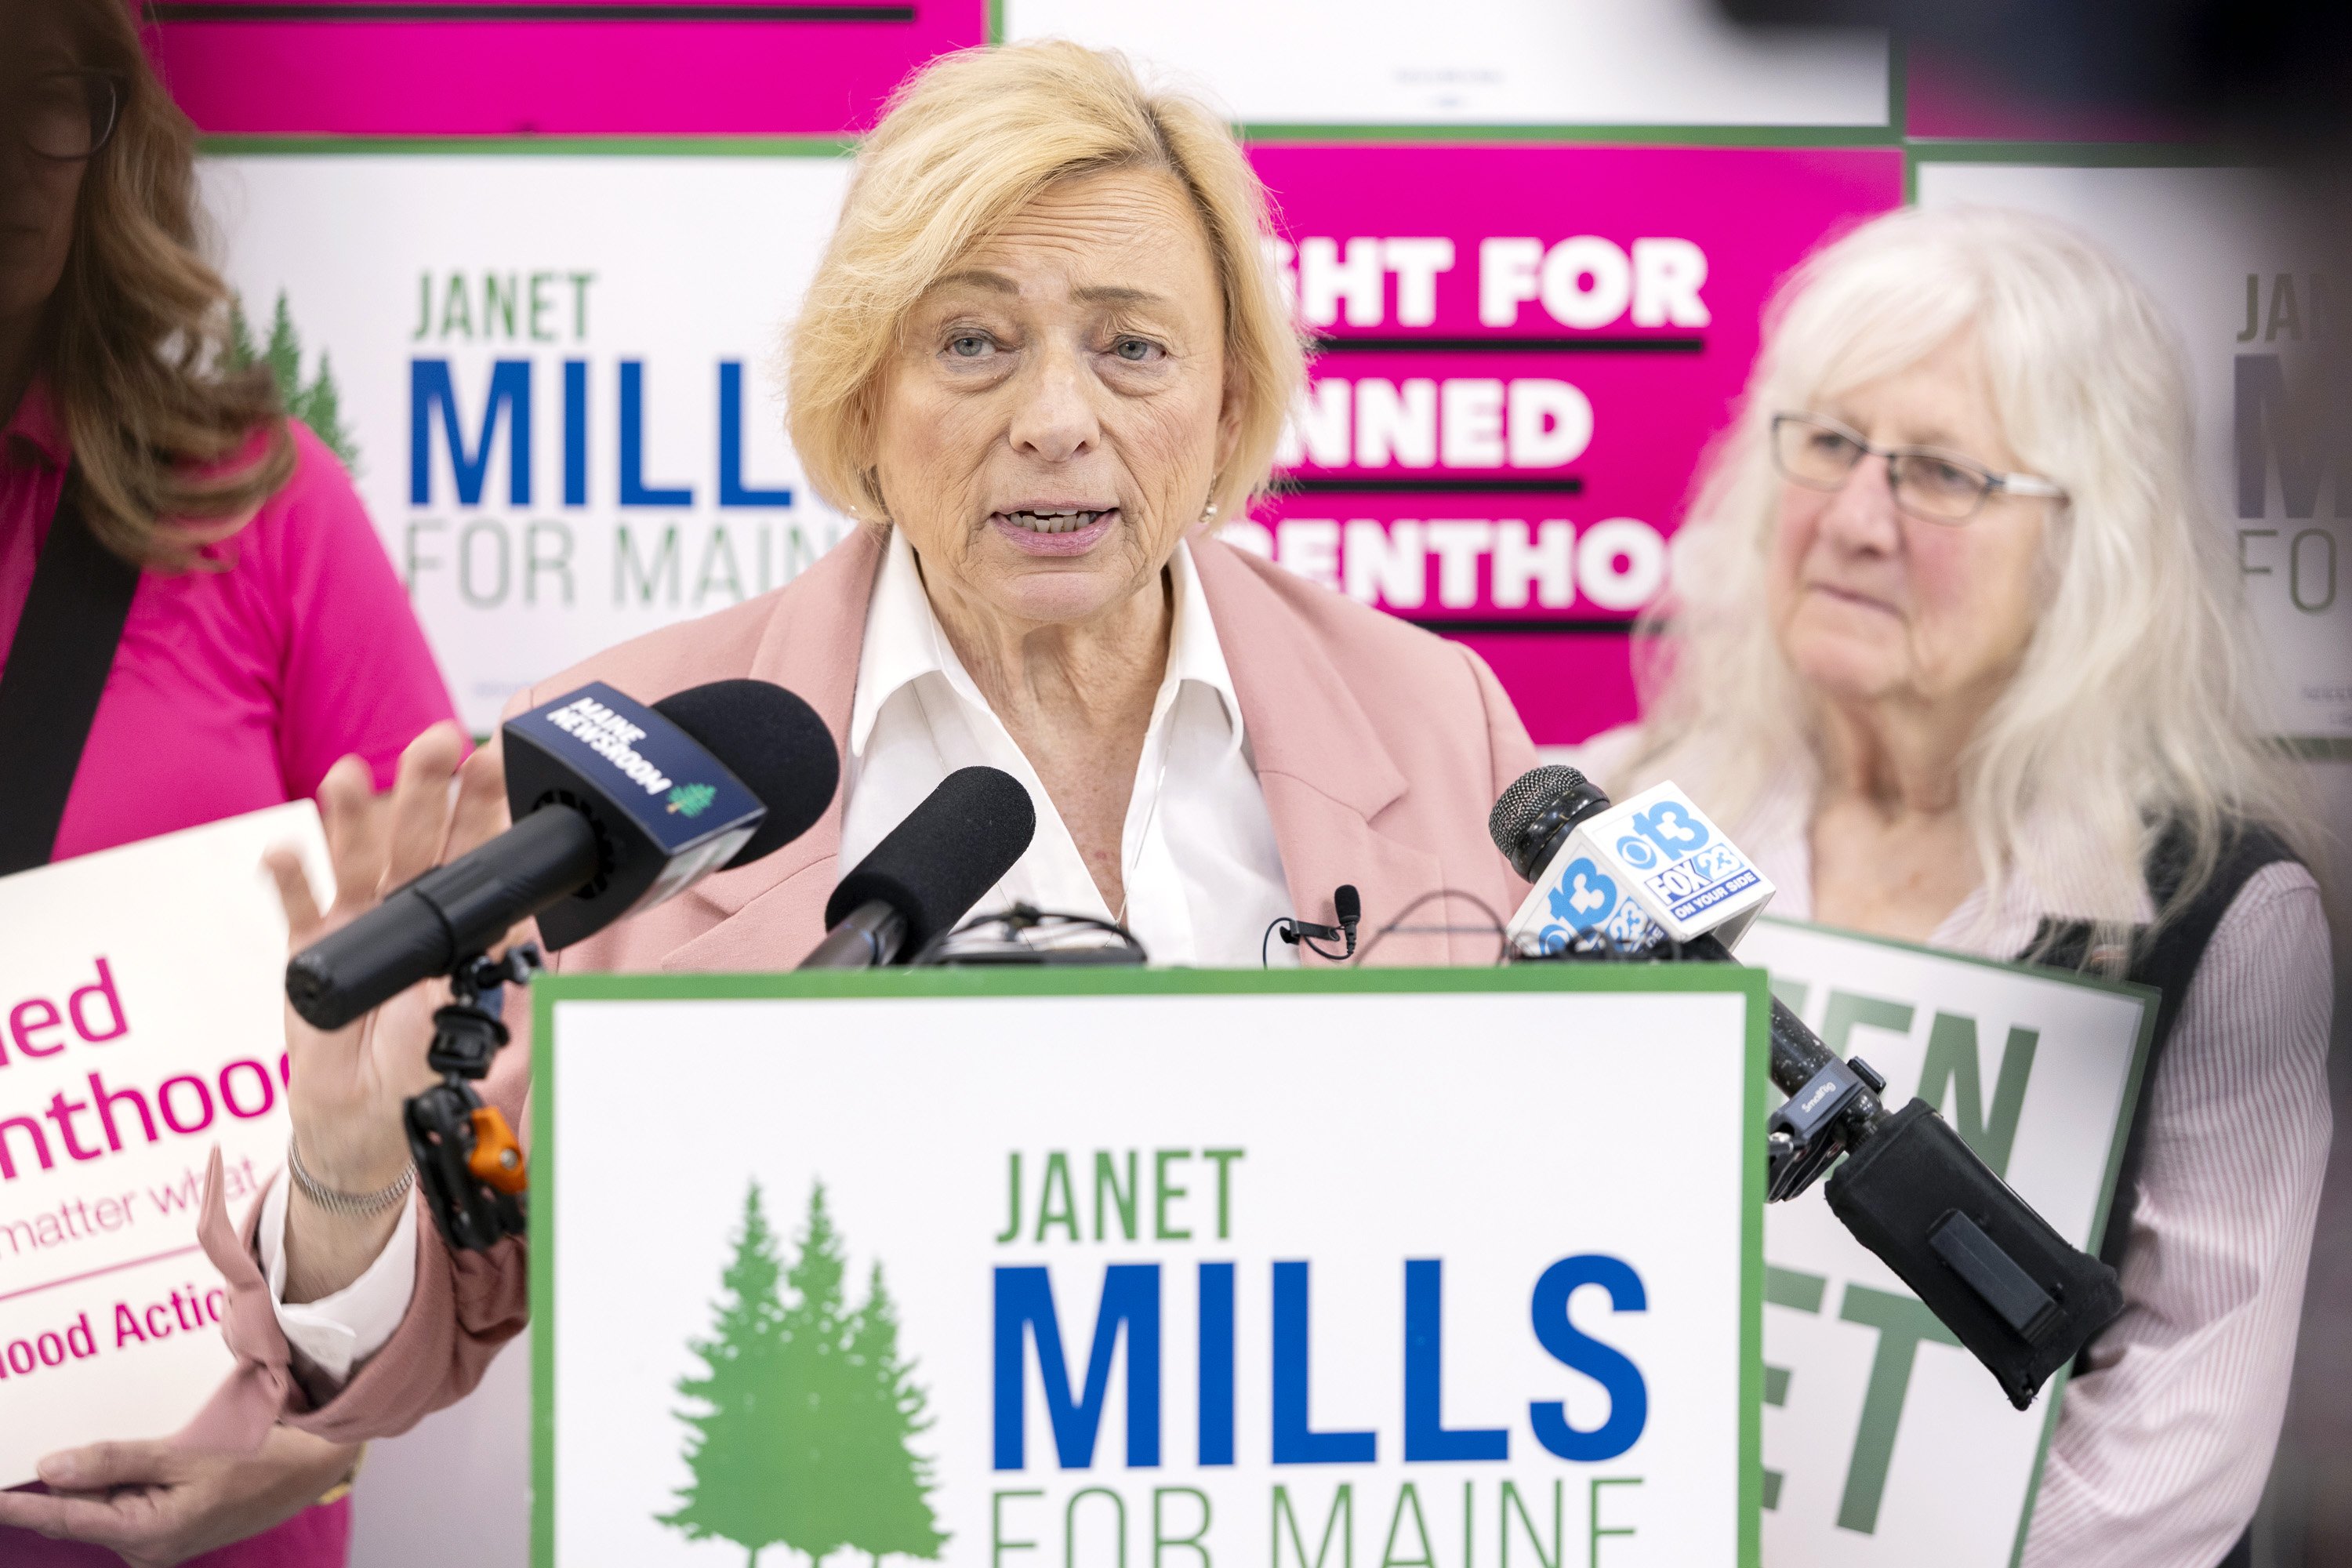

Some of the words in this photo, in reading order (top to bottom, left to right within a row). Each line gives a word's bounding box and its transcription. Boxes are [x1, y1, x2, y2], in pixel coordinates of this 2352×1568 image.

[413, 269, 595, 342] JANET
[1479, 235, 1711, 329] FOR
[405, 519, 579, 609] FOR
[1223, 517, 1686, 610] ENTHO
[546, 706, 673, 795] NEWSROOM
[569, 697, 647, 746] MAINE
[1632, 800, 1709, 862] 13
[1548, 857, 1617, 935] 13
[1645, 859, 1714, 906] FOX
[1697, 846, 1741, 879] 23
[1674, 902, 1697, 919] ON
[1693, 886, 1729, 909] YOUR
[1725, 871, 1757, 892] SIDE
[0, 958, 129, 1068] ed
[0, 1049, 291, 1179] nthoo
[1801, 1082, 1836, 1112] SmallRig
[996, 1149, 1246, 1244] JANET
[0, 1312, 99, 1380] ood
[993, 1253, 1649, 1471] MILLS
[992, 1486, 1213, 1568] FOR
[1271, 1477, 1645, 1568] MAINE
